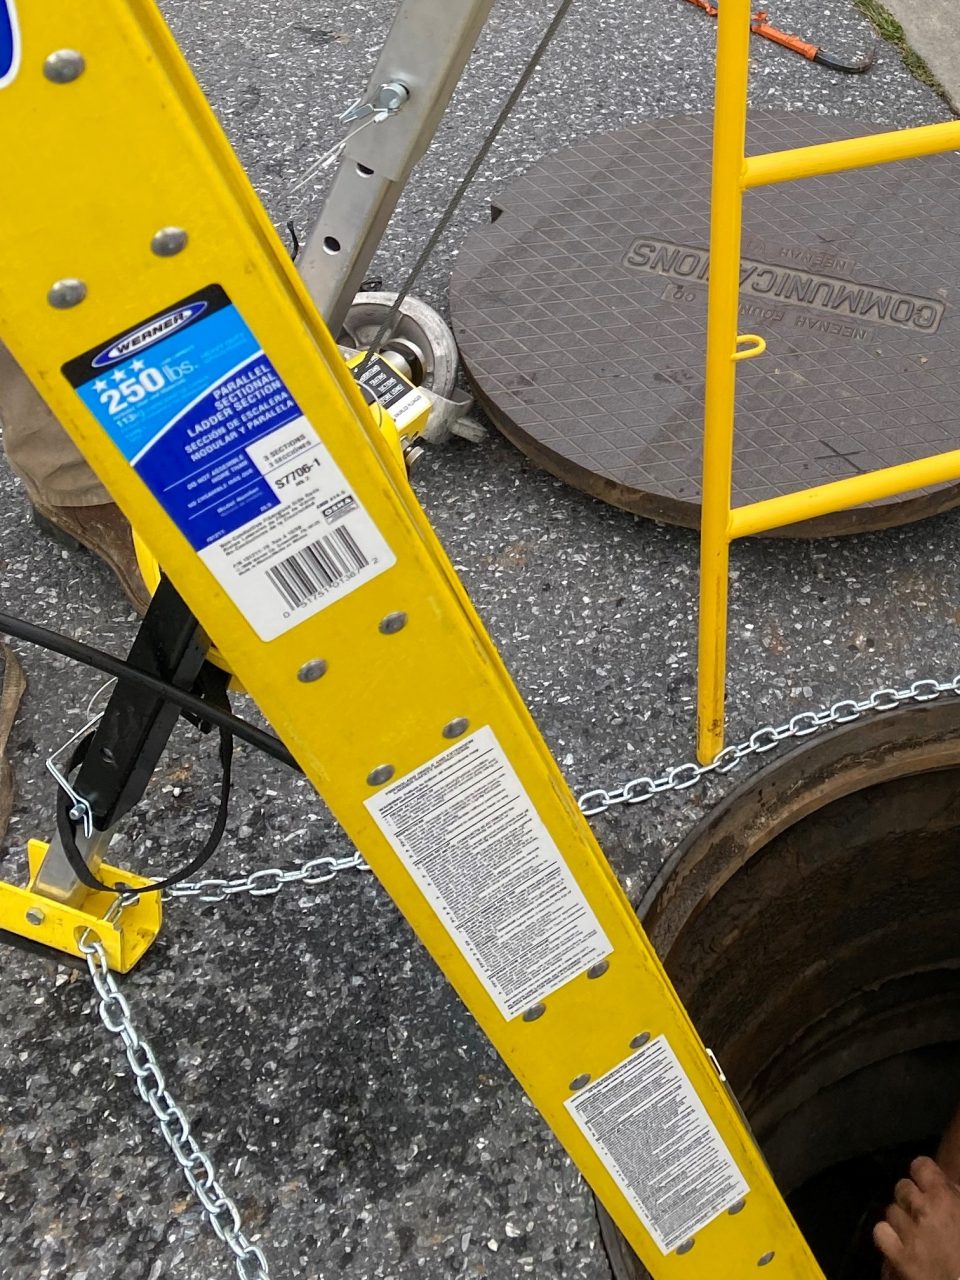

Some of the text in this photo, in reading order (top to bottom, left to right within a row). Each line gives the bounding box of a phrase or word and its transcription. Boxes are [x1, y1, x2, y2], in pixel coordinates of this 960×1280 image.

[627, 242, 939, 331] COMMUNICAIONS
[115, 311, 186, 354] WERNER
[794, 316, 869, 340] NEENAH
[99, 367, 166, 415] 250
[162, 360, 199, 383] lbs.
[212, 364, 270, 400] PARALLEL
[214, 372, 277, 411] SECTIONAL
[184, 391, 288, 454] SECCIÓN DE ESCALERA
[187, 380, 281, 438] LADDER SECTION
[190, 400, 294, 462] MODULAR Y PARALELA
[270, 433, 307, 457] SECTIONS
[274, 457, 321, 490] S7706-1
[323, 496, 353, 517] OSHA
